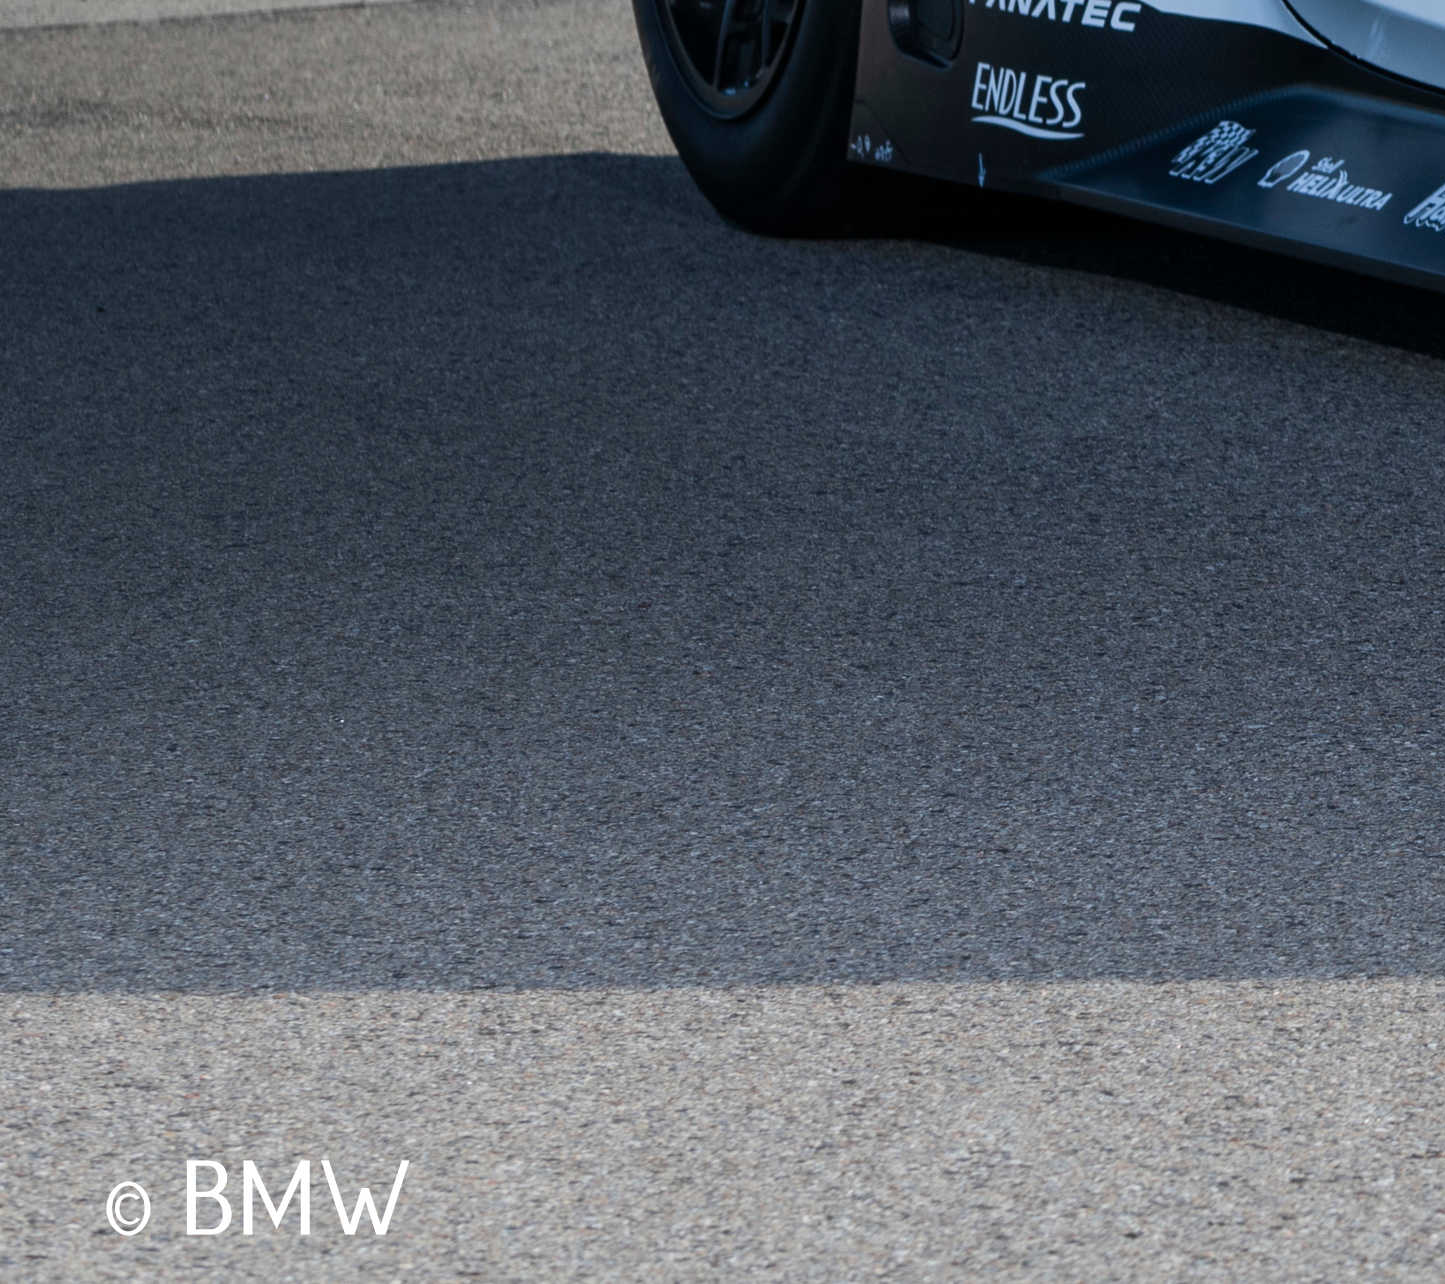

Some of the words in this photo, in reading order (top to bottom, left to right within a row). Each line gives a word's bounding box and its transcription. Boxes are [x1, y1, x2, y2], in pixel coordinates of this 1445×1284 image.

[971, 61, 1086, 129] ENDLESS
[1287, 170, 1348, 201] HELIX
[1335, 183, 1393, 211] ULTRA
